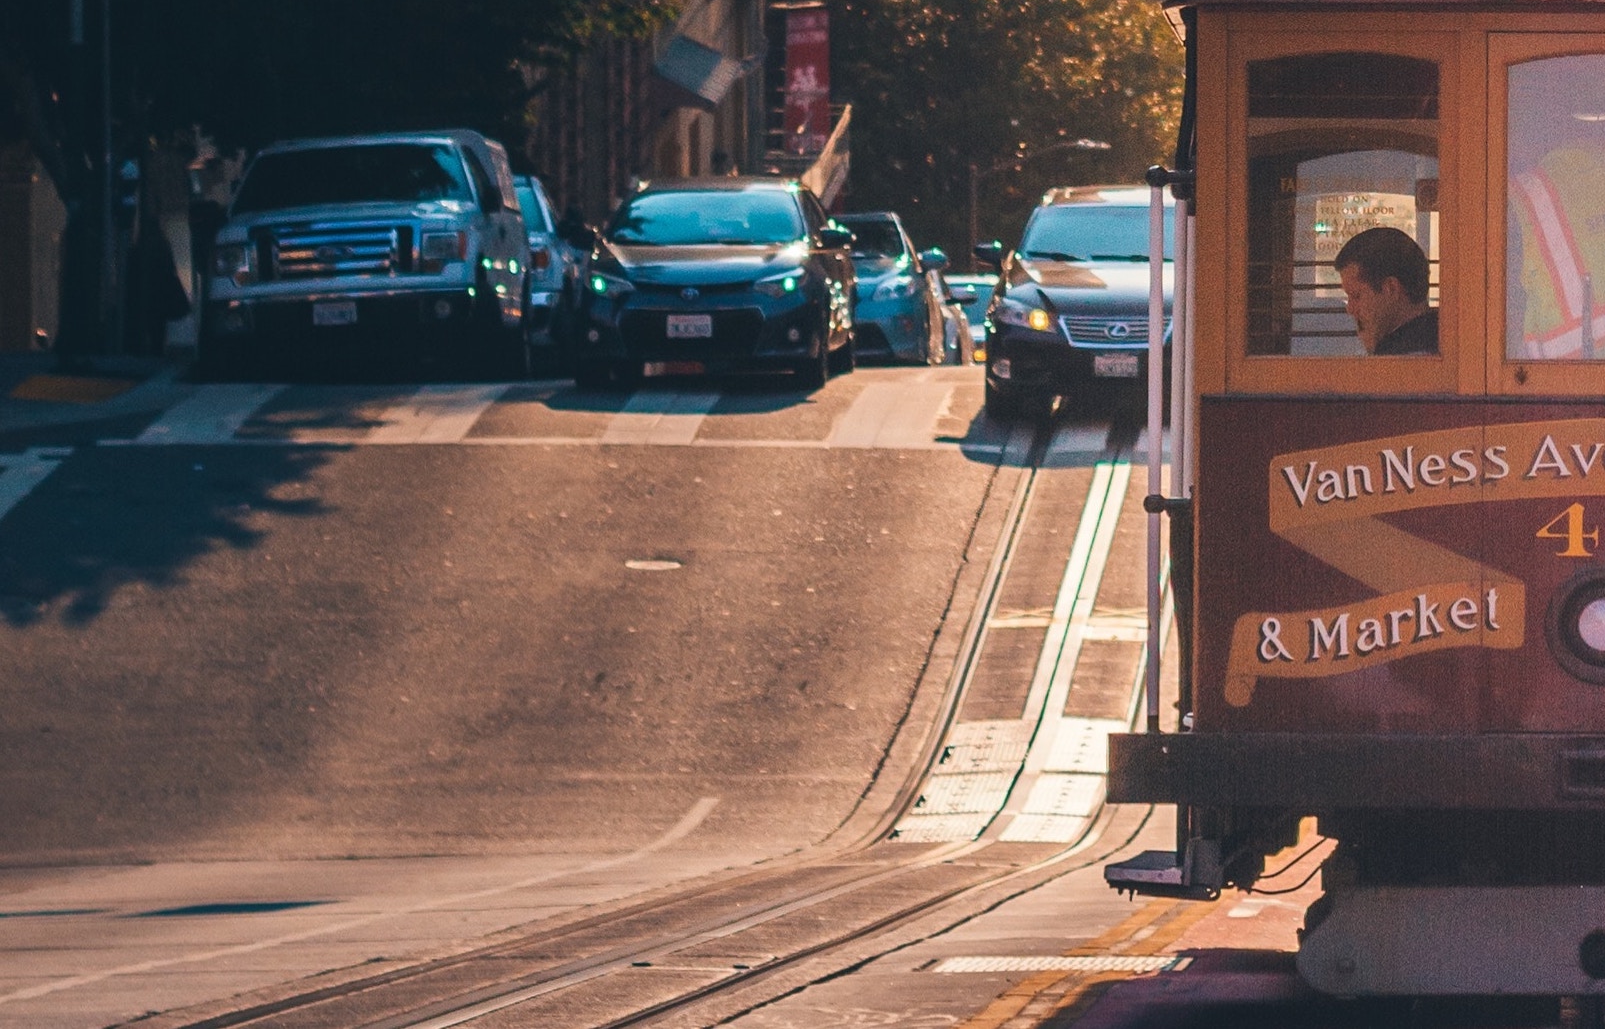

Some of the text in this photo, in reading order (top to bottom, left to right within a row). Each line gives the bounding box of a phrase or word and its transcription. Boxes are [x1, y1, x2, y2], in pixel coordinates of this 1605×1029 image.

[1282, 458, 1374, 508] Van
[1382, 444, 1511, 491] Ness
[1258, 587, 1502, 662] & Market
